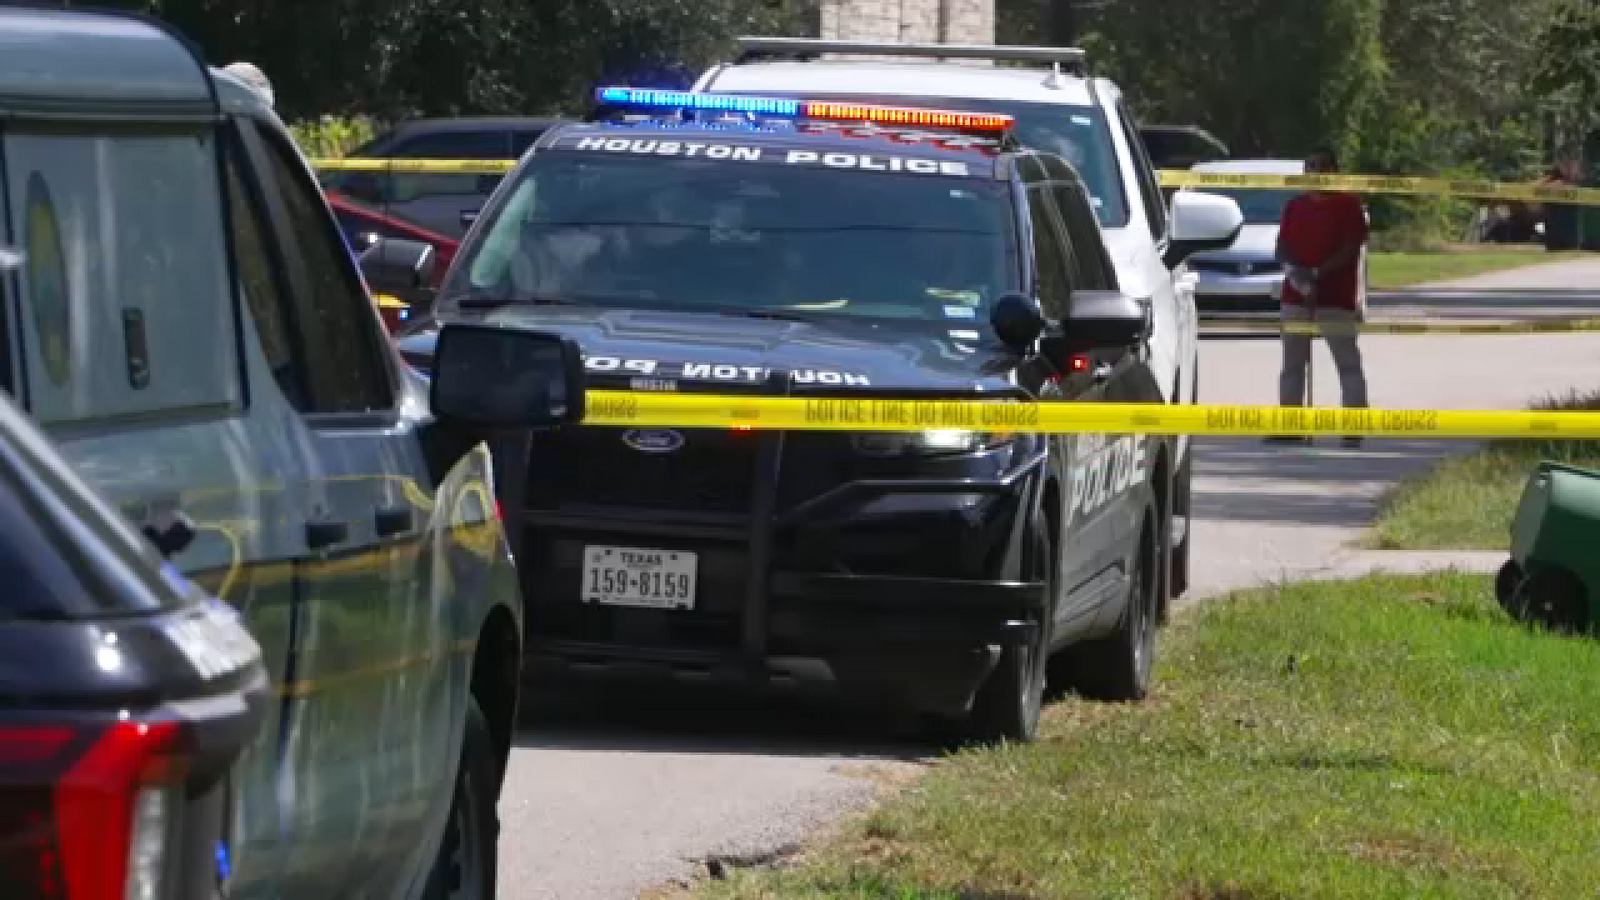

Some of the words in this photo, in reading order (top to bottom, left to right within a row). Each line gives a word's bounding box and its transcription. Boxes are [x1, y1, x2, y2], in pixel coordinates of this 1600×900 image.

[576, 136, 761, 161] HOUSTON
[786, 150, 968, 176] POLICE
[1065, 434, 1146, 528] POLICE
[620, 552, 662, 564] TEXAS
